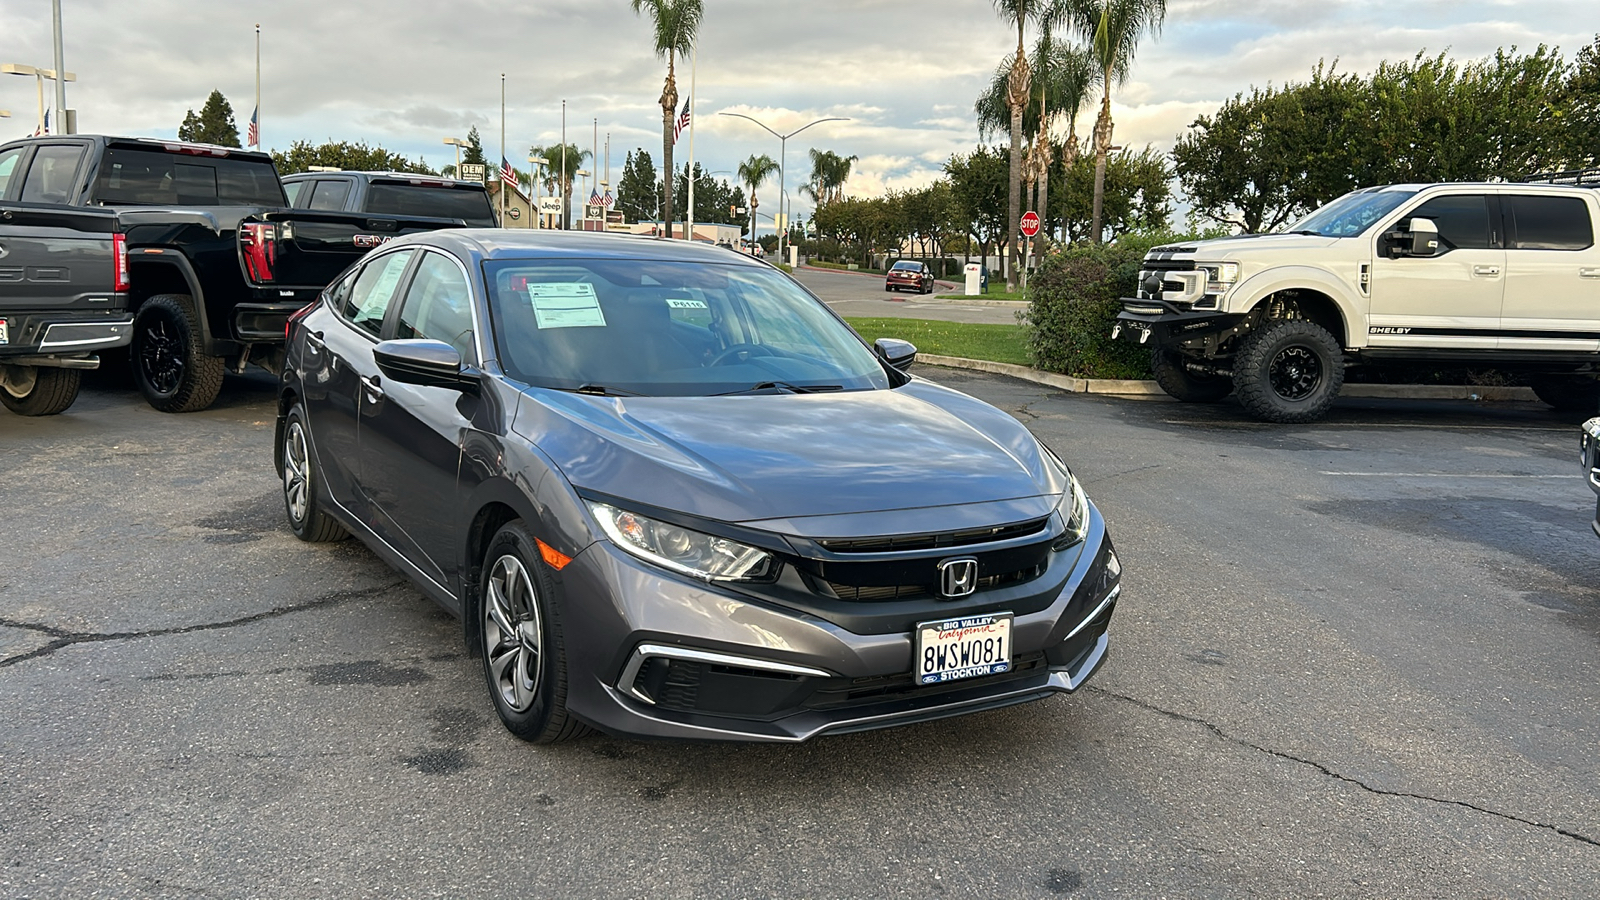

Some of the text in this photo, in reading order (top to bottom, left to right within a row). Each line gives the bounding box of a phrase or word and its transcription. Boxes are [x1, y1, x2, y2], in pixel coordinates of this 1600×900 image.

[462, 166, 483, 174] OEM
[542, 202, 561, 212] Jeep
[1022, 219, 1038, 229] STOP
[353, 234, 394, 248] GM
[943, 617, 992, 630] BIG VALLEY
[938, 625, 996, 641] California
[924, 636, 1004, 672] 8WSW081
[940, 665, 991, 681] STOCKTON
